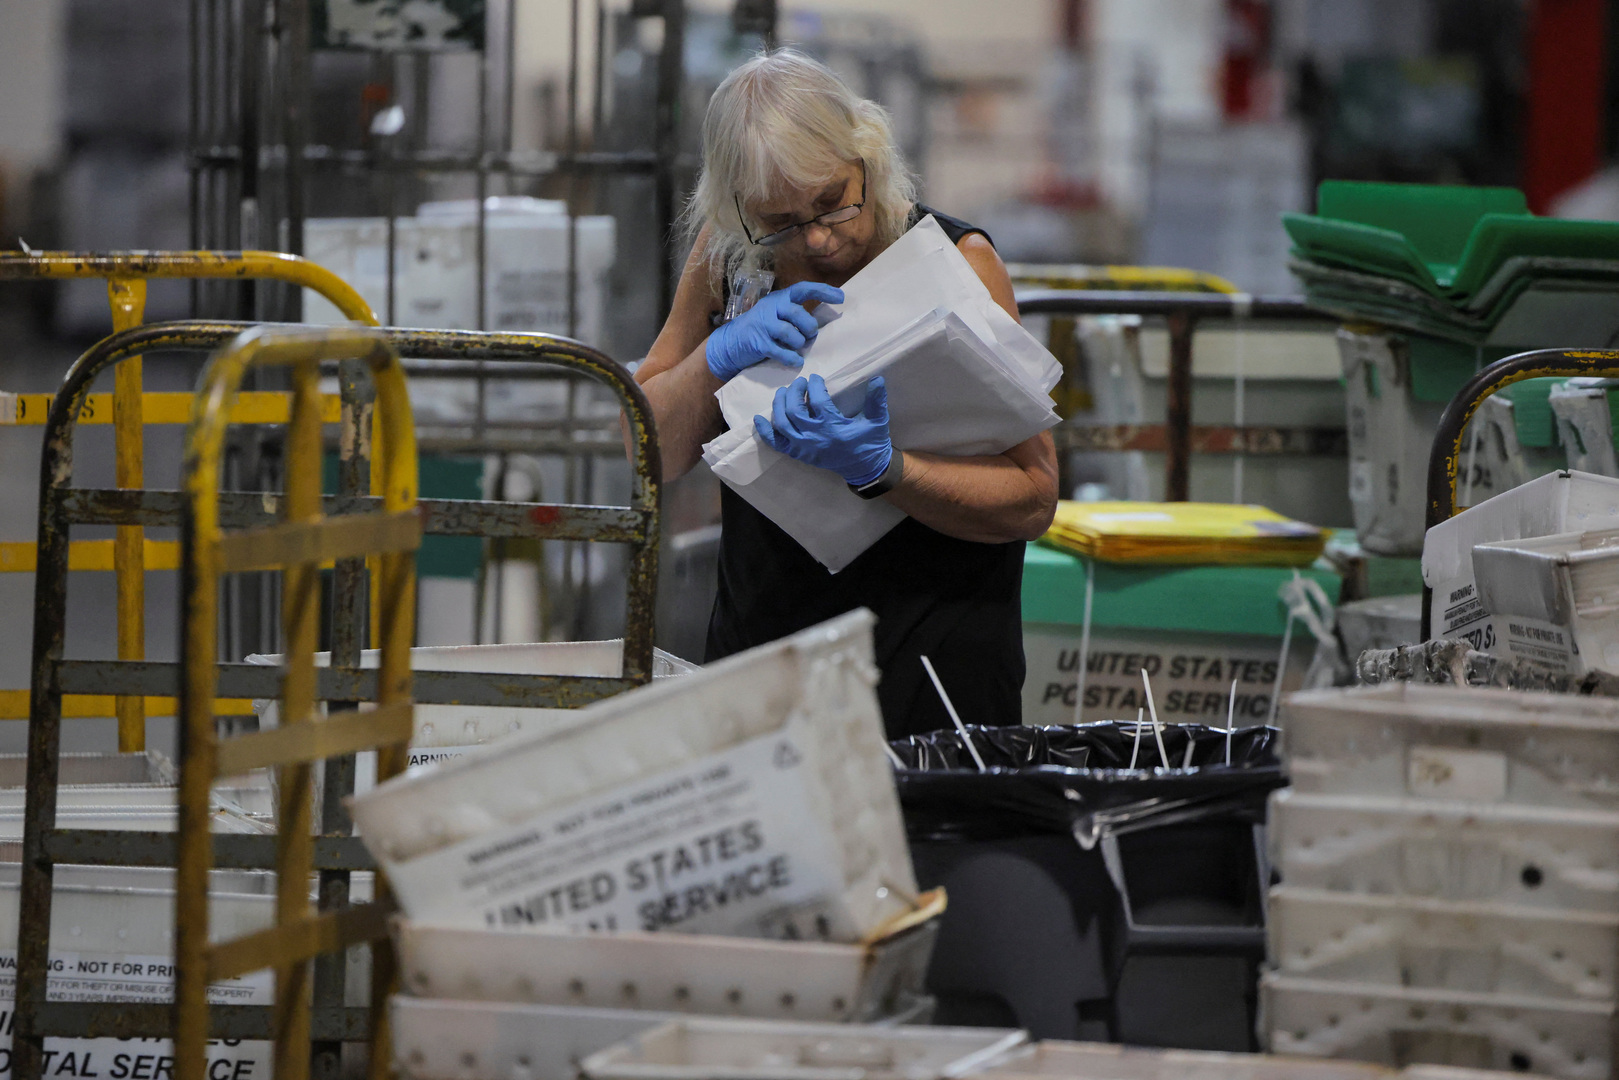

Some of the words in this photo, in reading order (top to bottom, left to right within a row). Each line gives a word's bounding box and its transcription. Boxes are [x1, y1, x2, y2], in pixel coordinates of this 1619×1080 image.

[1056, 649, 1163, 678] UNITED
[1168, 654, 1279, 684] STATES
[1164, 689, 1280, 719] SERVIC
[625, 819, 766, 893] STATES
[637, 852, 794, 932] SERVICE
[77, 961, 108, 974] NOT
[112, 962, 143, 976] FOR
[206, 987, 254, 998] PROPERTY
